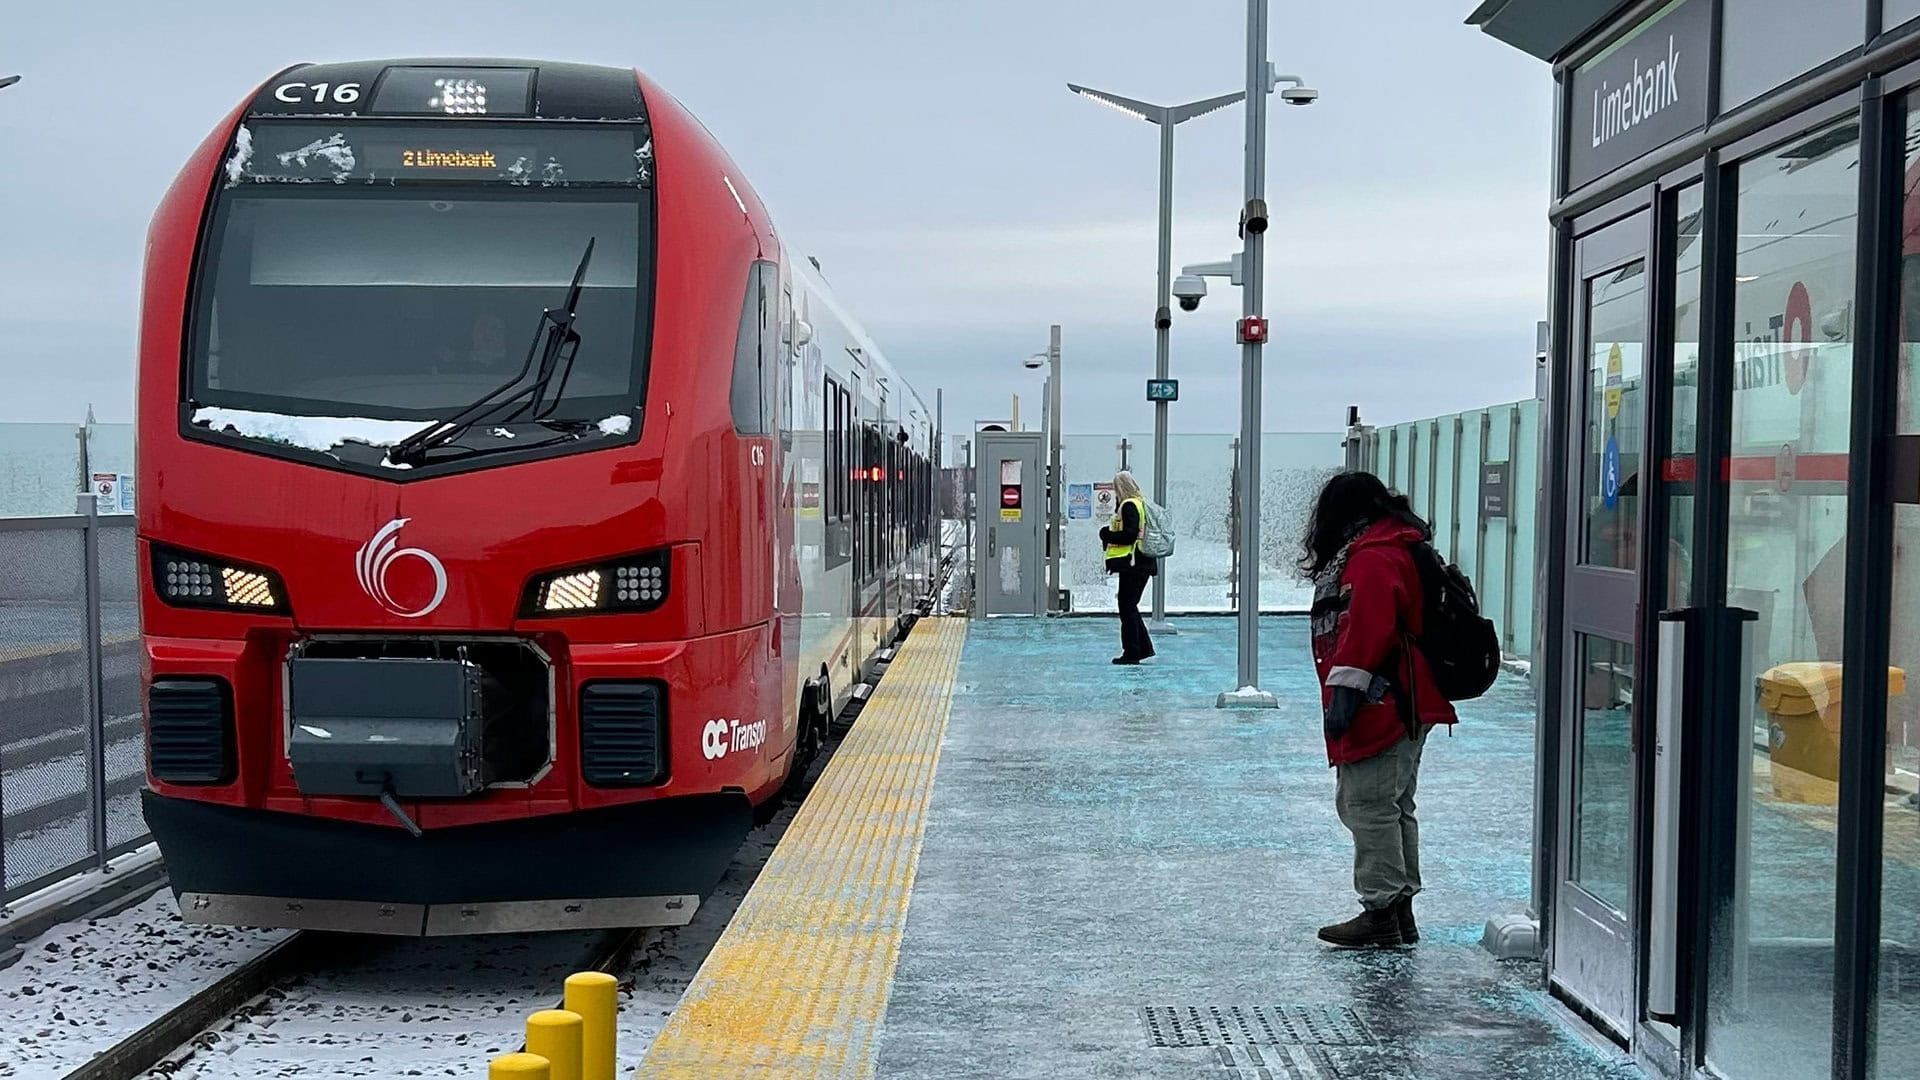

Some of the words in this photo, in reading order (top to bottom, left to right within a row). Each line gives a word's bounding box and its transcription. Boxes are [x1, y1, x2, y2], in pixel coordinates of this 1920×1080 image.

[274, 82, 361, 103] C16
[1592, 34, 1680, 148] Limebank
[403, 150, 414, 167] 2
[416, 149, 497, 168] Limebank
[751, 444, 765, 466] C16
[702, 718, 729, 760] OC
[730, 719, 767, 755] Transpo
